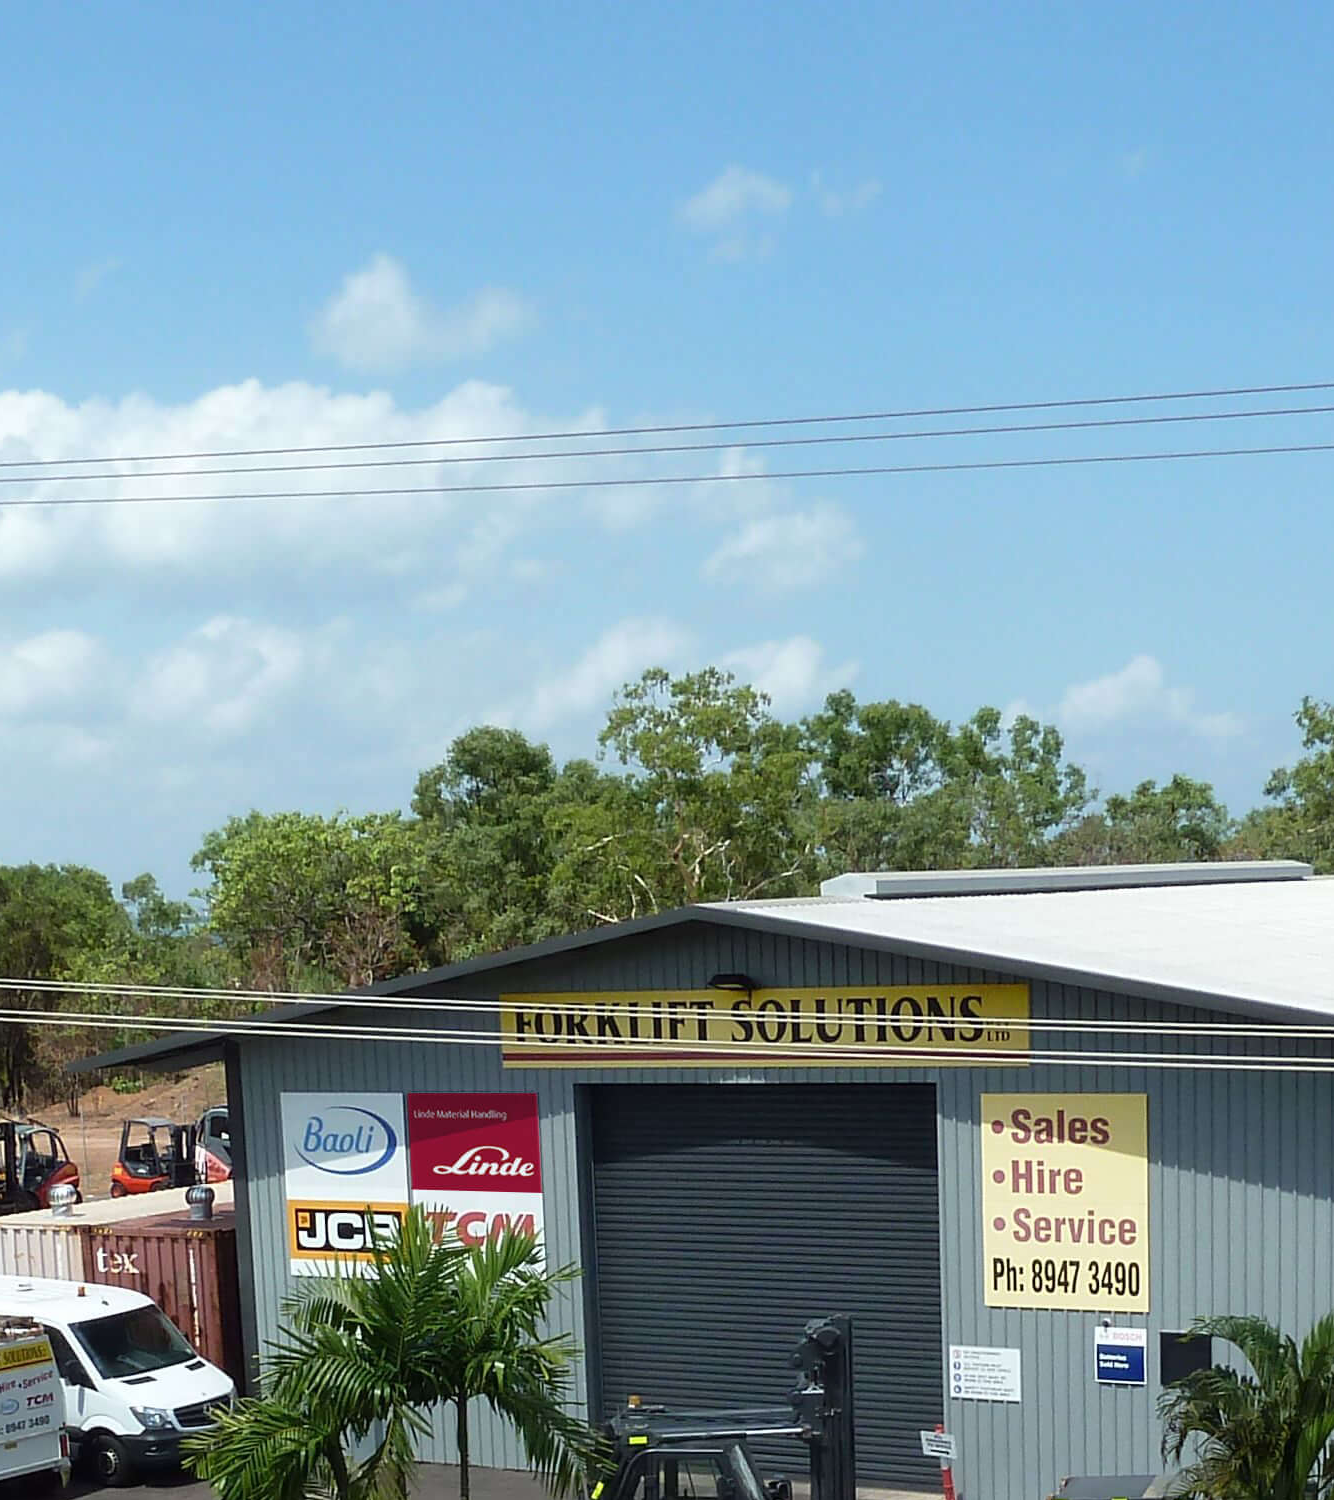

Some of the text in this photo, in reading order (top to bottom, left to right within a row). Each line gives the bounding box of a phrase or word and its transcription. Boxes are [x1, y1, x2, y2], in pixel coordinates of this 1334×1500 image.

[515, 996, 984, 1045] FORKLIFT SOLUTIONS
[986, 1031, 1010, 1042] LTD
[413, 1109, 507, 1121] Linde Material Handling
[1011, 1109, 1110, 1144] Sales
[303, 1116, 374, 1154] Baoli
[433, 1145, 535, 1177] Linde
[1011, 1160, 1083, 1194] Hire
[1012, 1208, 1137, 1245] Service
[97, 1247, 140, 1274] tex
[992, 1257, 1140, 1296] Ph: 8947 3490
[22, 1370, 53, 1389] Service
[26, 1392, 54, 1406] TCM
